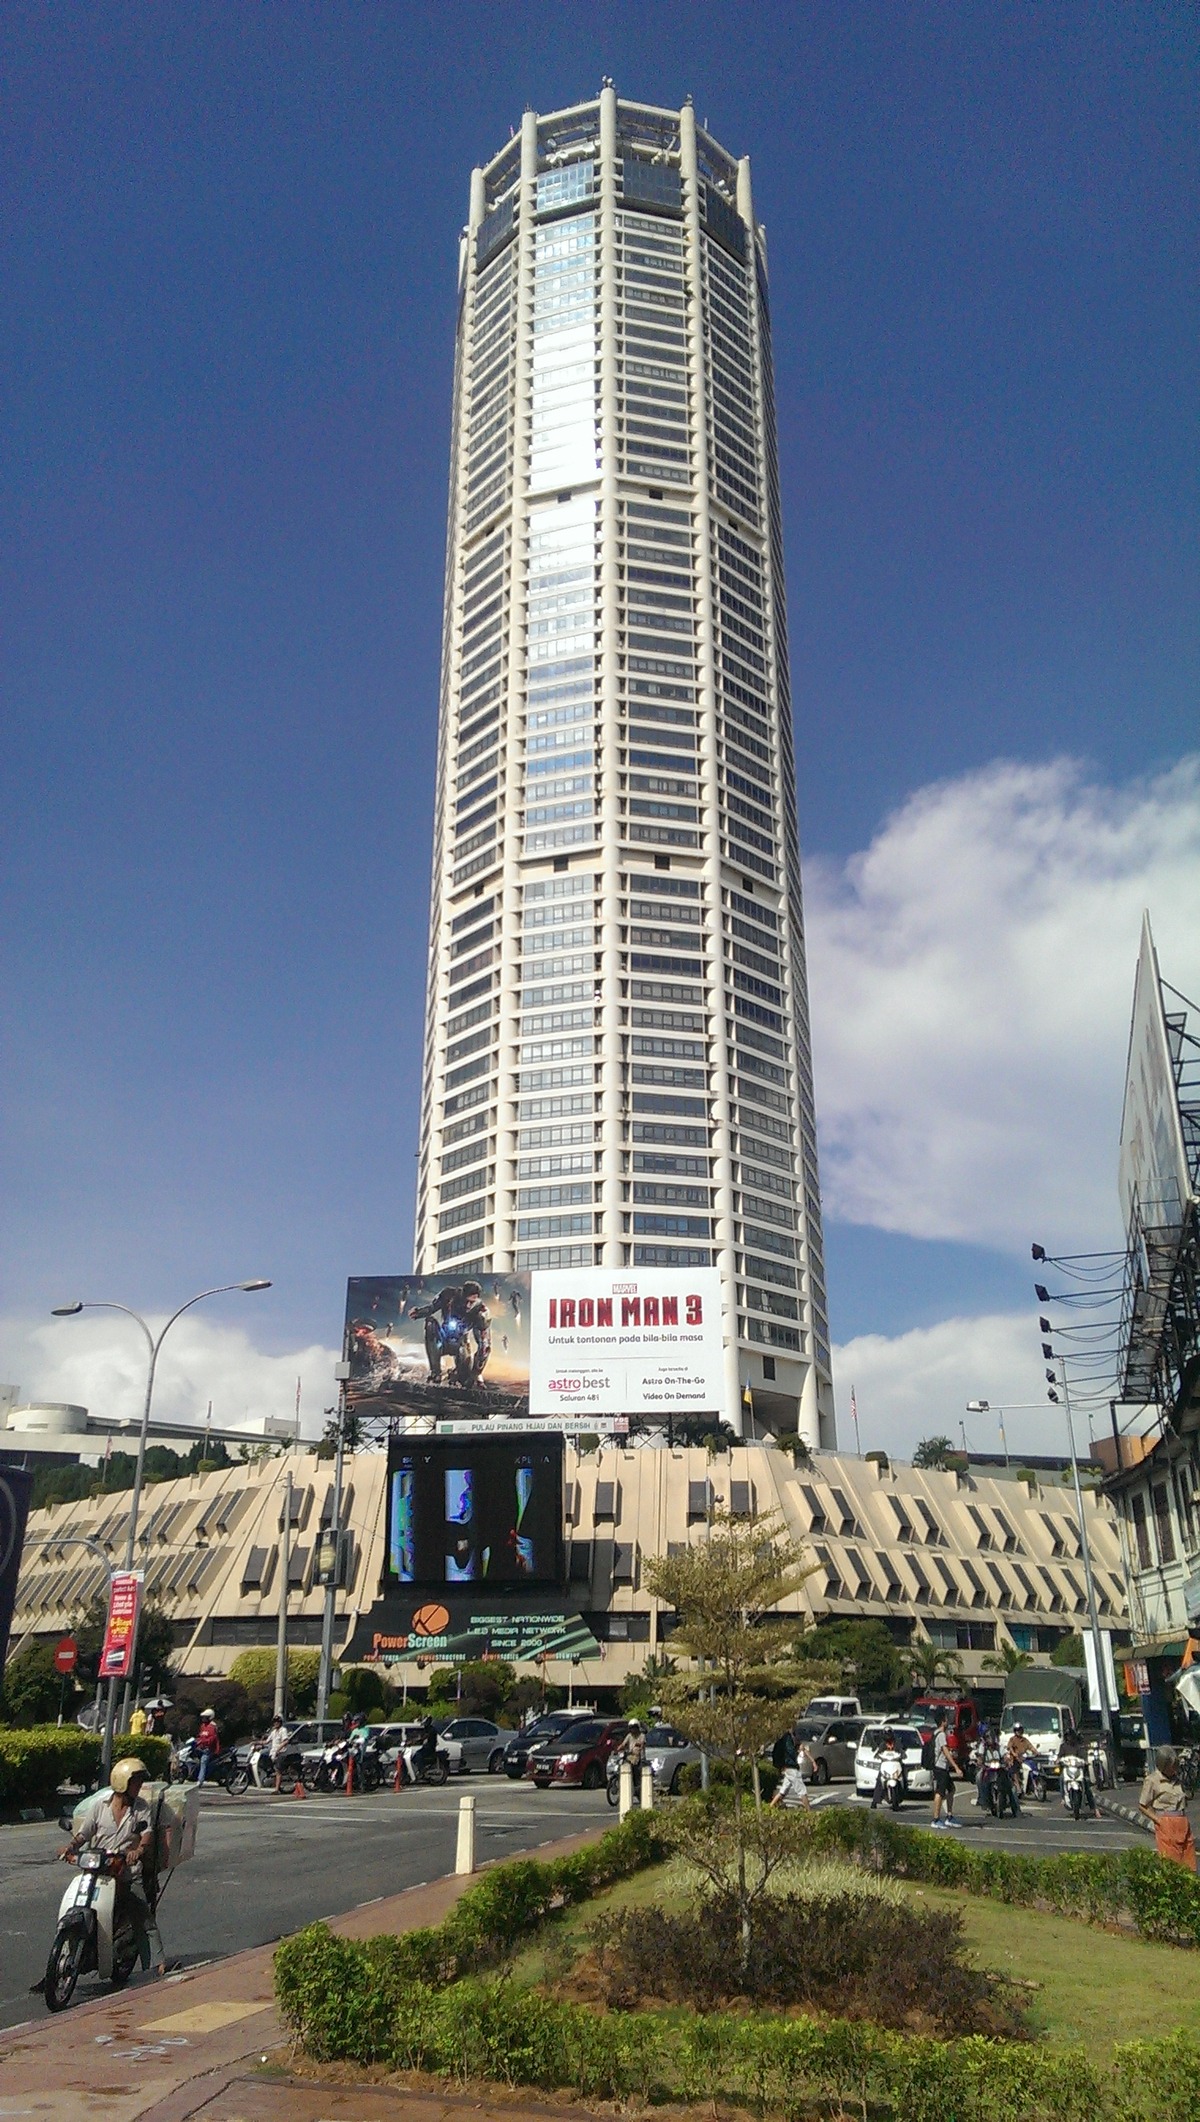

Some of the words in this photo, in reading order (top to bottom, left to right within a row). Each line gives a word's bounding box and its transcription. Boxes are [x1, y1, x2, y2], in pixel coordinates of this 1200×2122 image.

[612, 1284, 638, 1294] MARVEL
[549, 1297, 613, 1328] IRON
[621, 1296, 678, 1327] MAN
[686, 1294, 703, 1326] 3
[548, 1336, 574, 1344] Untuk
[576, 1336, 616, 1344] tontonan
[619, 1335, 640, 1344] pada
[643, 1334, 678, 1343] bila-bila
[548, 1378, 581, 1390] astro
[582, 1376, 610, 1388] best
[497, 1423, 524, 1431] PINANG
[514, 1456, 550, 1464] XPEA
[470, 1616, 508, 1624] BIGGEST
[512, 1615, 565, 1623] NATIONWIDE
[373, 1632, 447, 1648] PowerScreen
